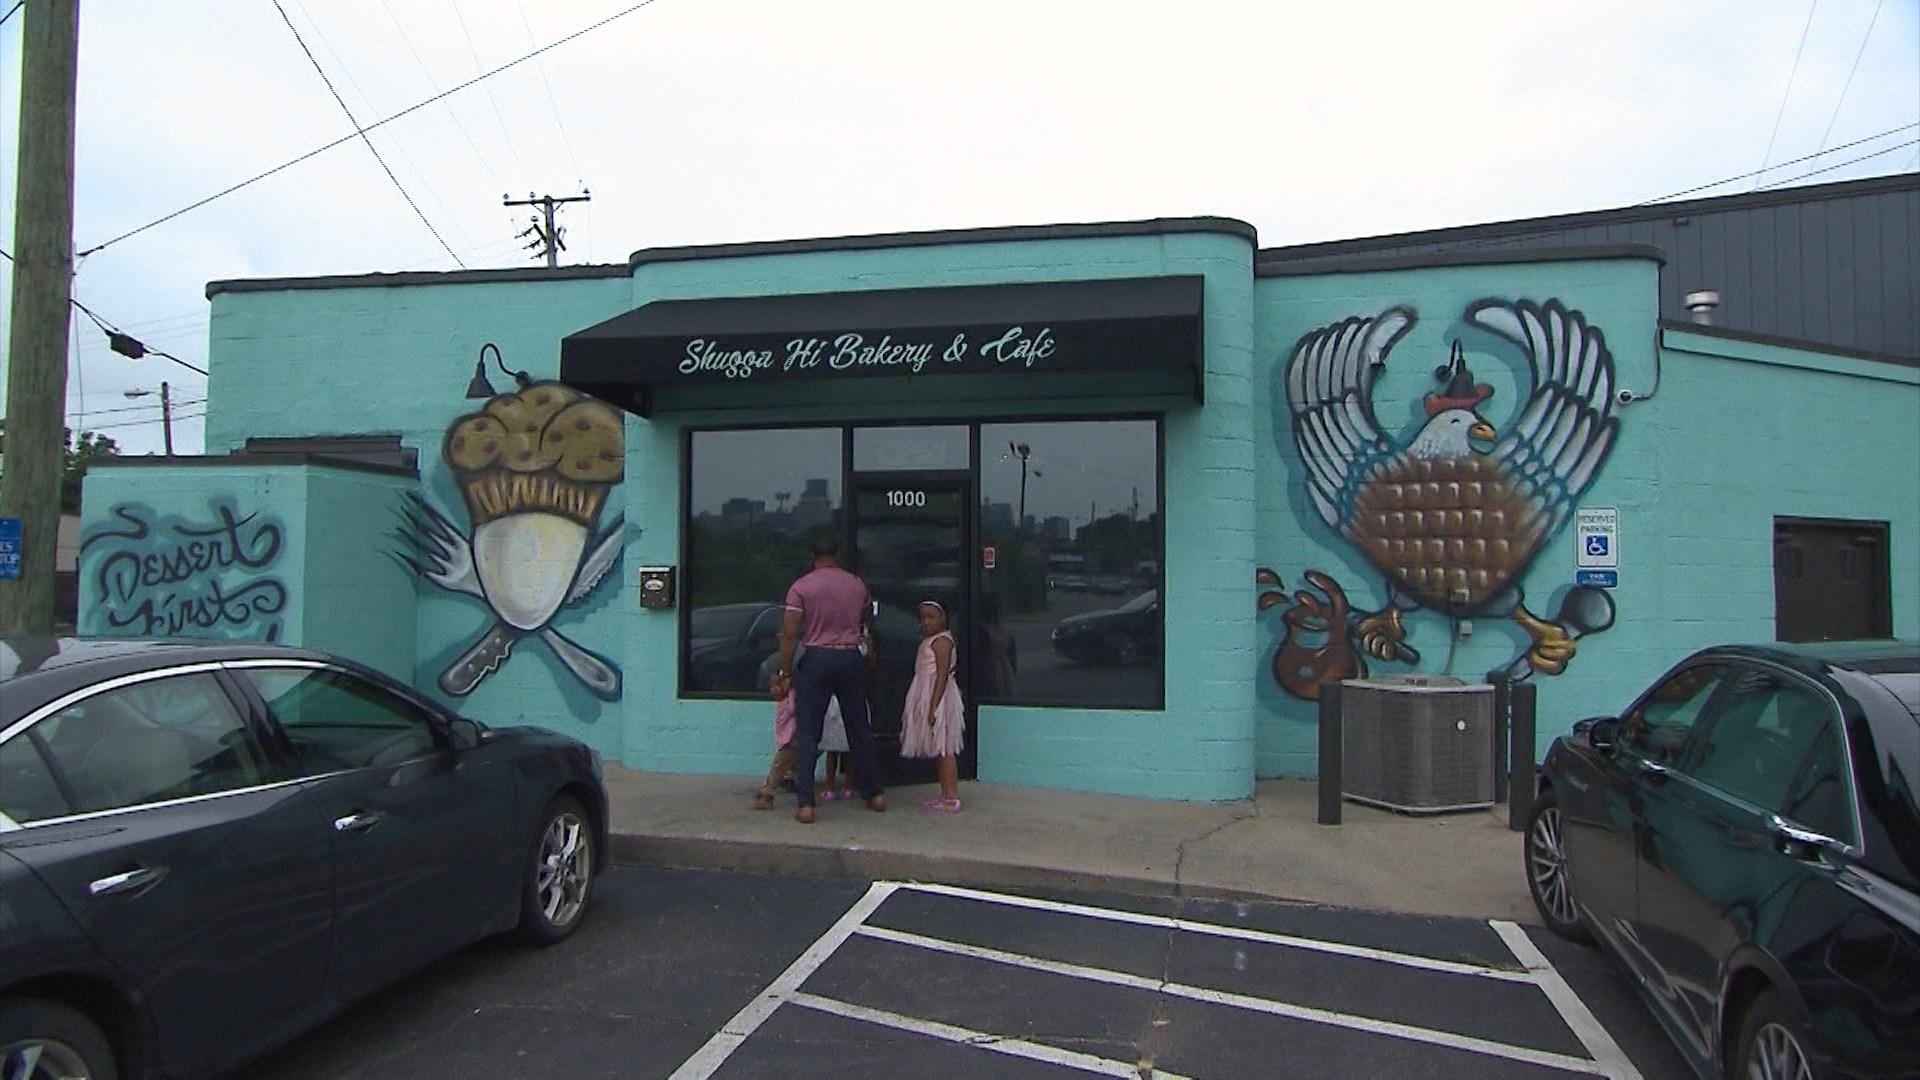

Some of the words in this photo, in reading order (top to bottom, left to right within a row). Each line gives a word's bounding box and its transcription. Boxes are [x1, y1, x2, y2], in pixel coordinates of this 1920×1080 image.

[678, 338, 774, 379] Shugga
[783, 337, 829, 372] Hi
[828, 332, 934, 372] Bakery
[942, 332, 968, 362] &
[886, 490, 926, 507] 1000
[1580, 524, 1614, 534] PARKING
[98, 505, 281, 603] Dessert
